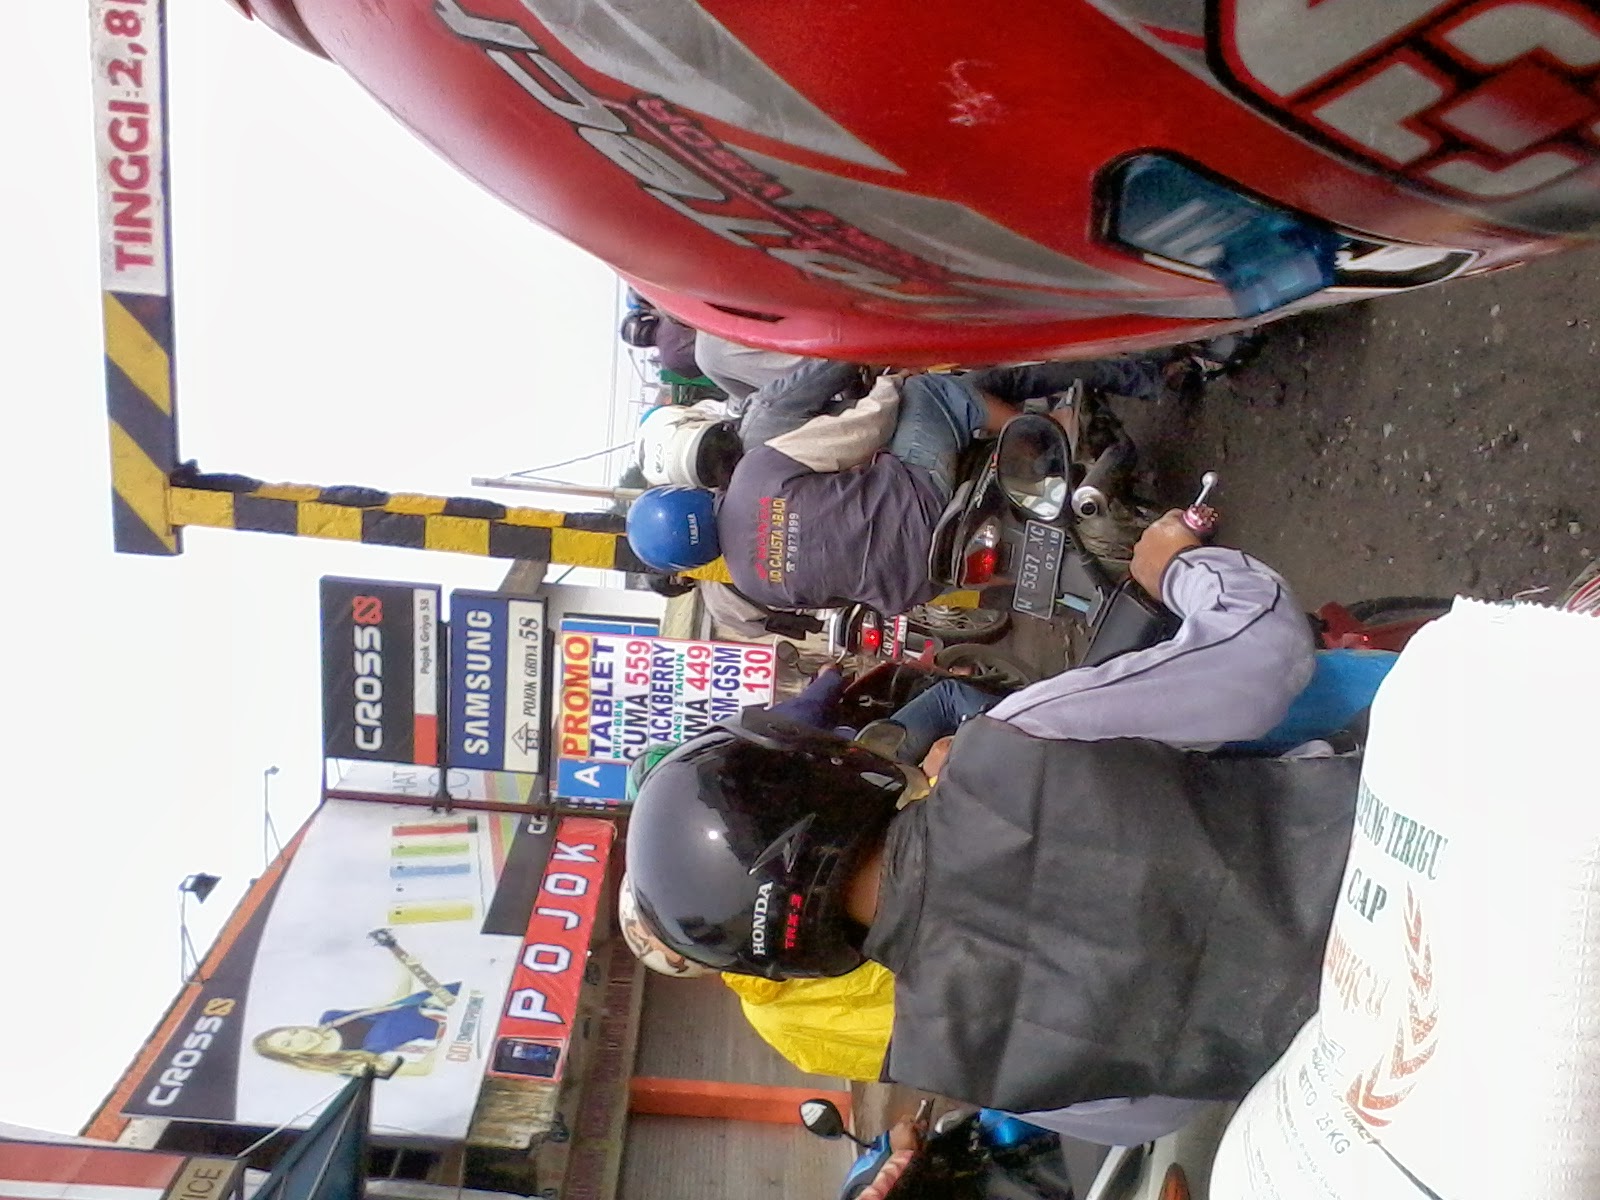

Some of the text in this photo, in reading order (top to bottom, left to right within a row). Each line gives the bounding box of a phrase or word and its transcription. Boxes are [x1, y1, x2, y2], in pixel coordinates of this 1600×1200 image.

[1021, 553, 1041, 589] 5337
[420, 614, 432, 643] Griya
[518, 617, 539, 642] 58
[463, 609, 493, 755] SAMSUNG
[524, 645, 538, 678] GRIYA
[675, 654, 685, 697] TAHUN
[685, 645, 711, 691] 449
[712, 647, 741, 722] SM-GSM
[742, 649, 772, 693] 130
[563, 636, 590, 757] PROMO
[589, 638, 615, 757] TABLET
[623, 640, 651, 760] CUMA 559
[648, 643, 675, 742] ACKBERRY
[1384, 811, 1449, 881] TERIGU
[752, 881, 774, 956] HONDA
[1347, 867, 1388, 924] CAP
[504, 840, 600, 1024] POJOK
[1326, 1128, 1351, 1155] KG
[180, 1168, 224, 1200] ICE
